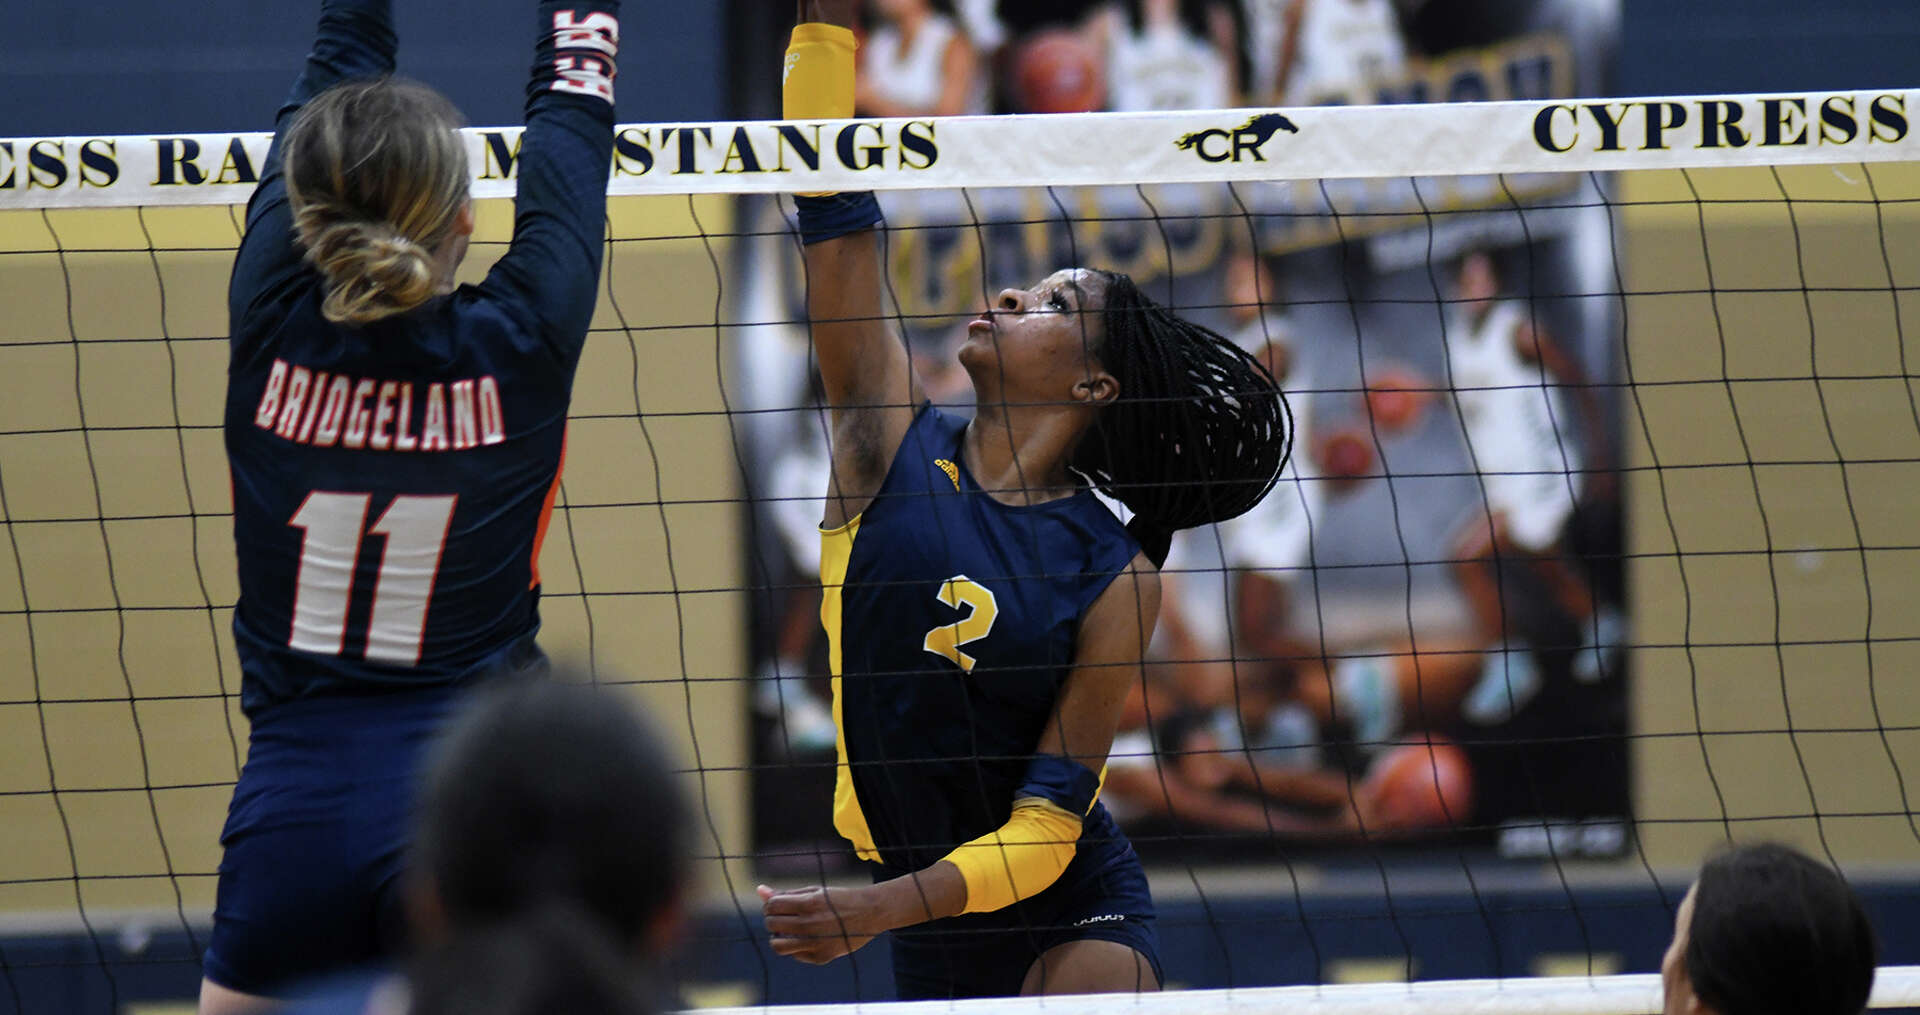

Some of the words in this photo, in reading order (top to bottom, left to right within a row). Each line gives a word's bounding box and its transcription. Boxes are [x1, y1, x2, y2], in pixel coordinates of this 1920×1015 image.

[478, 120, 939, 180] MSTANGS
[1196, 128, 1267, 162] CR
[1533, 94, 1910, 153] CYPRESS
[254, 358, 506, 451] BRIDGELAND
[288, 490, 459, 668] 11
[923, 575, 999, 674] 2
